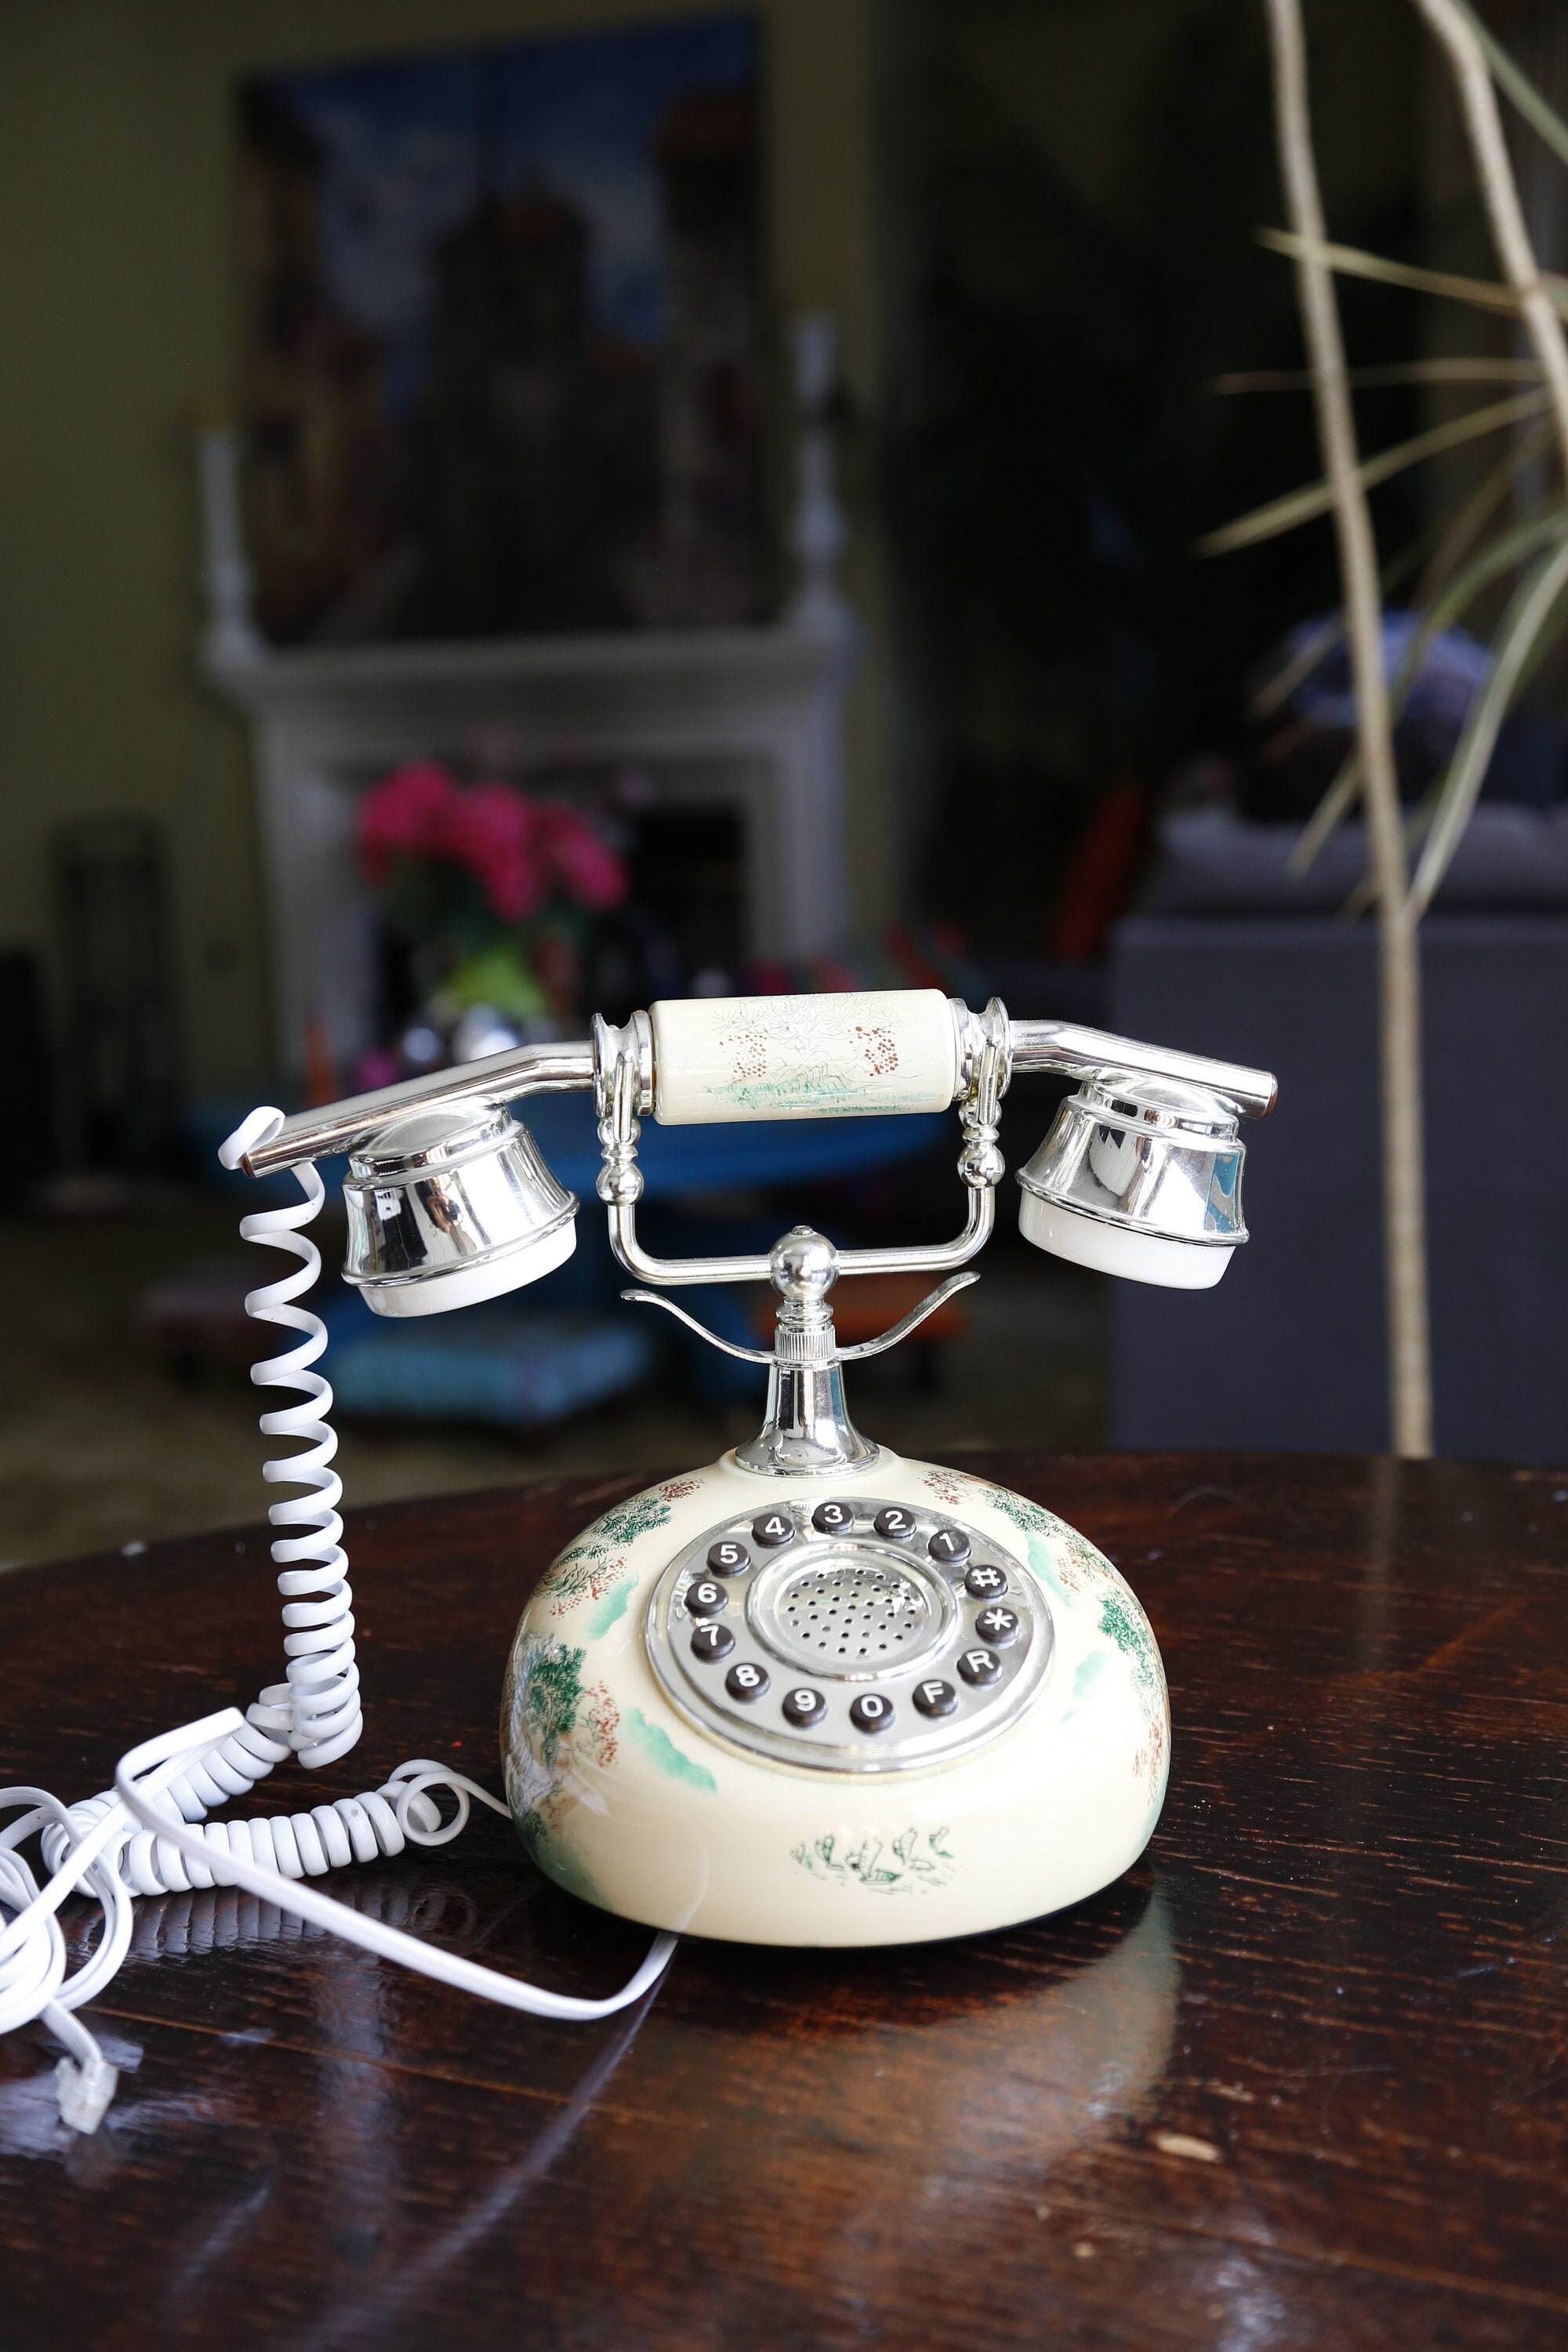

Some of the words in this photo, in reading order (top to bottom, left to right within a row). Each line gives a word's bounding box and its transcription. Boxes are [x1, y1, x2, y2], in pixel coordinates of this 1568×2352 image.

[824, 1504, 844, 1524] 3
[884, 1510, 906, 1530] 2
[764, 1516, 786, 1536] 4
[938, 1532, 955, 1552] 1
[720, 1544, 739, 1564] 5
[971, 1567, 1001, 1588] #
[697, 1582, 717, 1603] 6
[699, 1624, 720, 1646] 7
[965, 1650, 995, 1673] R
[735, 1664, 760, 1687] 8
[793, 1689, 817, 1712] 9
[921, 1680, 945, 1704] F
